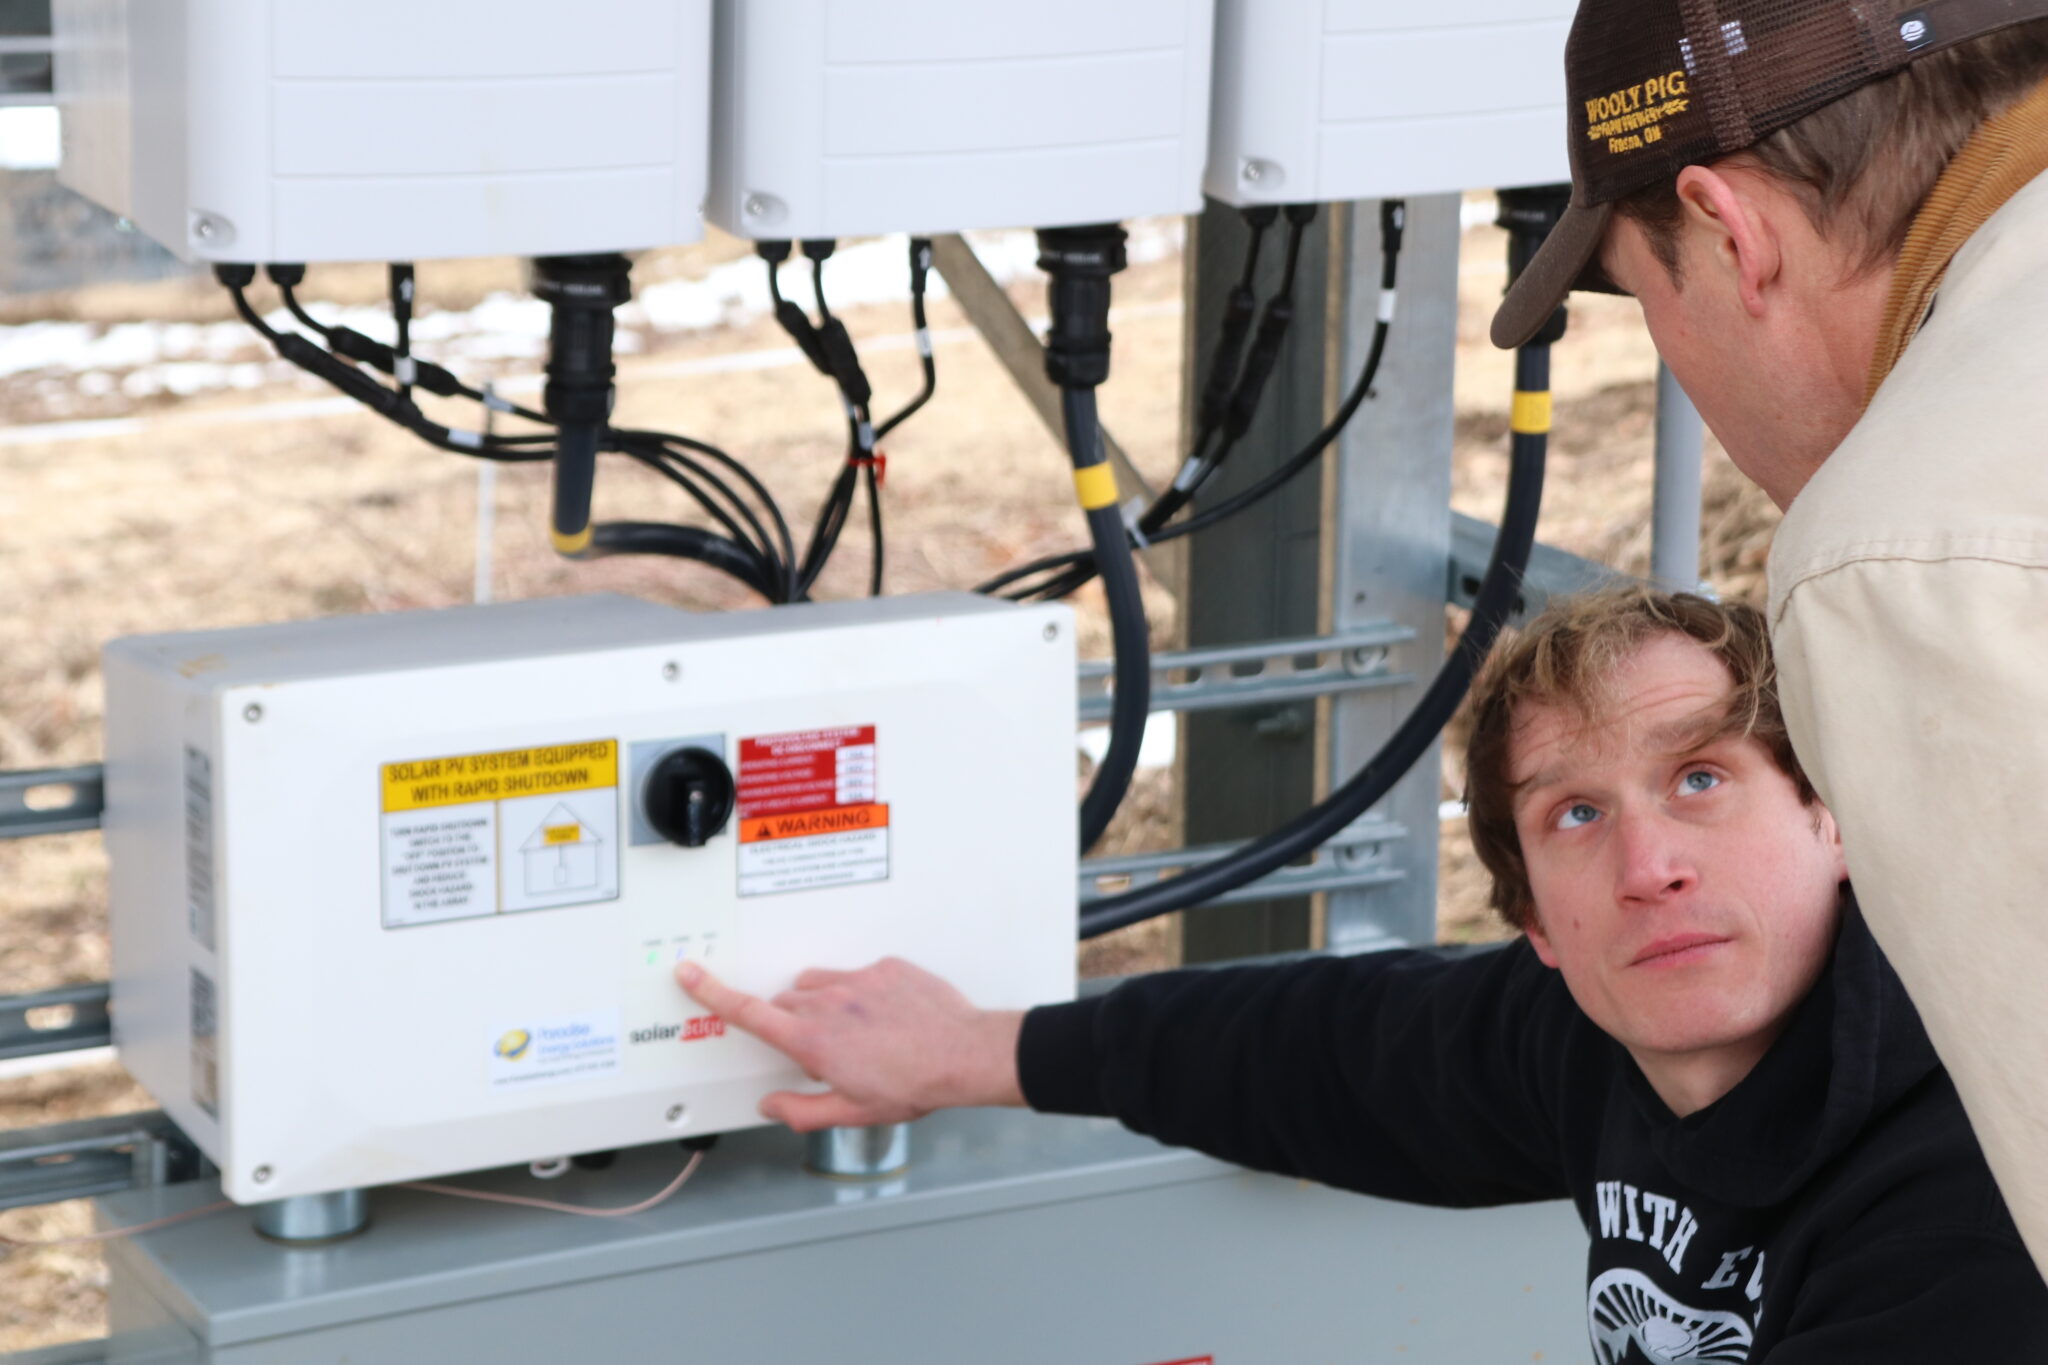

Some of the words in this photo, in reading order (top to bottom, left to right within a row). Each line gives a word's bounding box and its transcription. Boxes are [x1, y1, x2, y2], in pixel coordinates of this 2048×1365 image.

[1585, 84, 1642, 123] WOOLY
[1644, 71, 1688, 105] PIG
[389, 763, 440, 783] SOLAR
[445, 759, 464, 777] PV
[470, 751, 529, 774] SYSTEM
[533, 743, 608, 767] EQUIPPED
[411, 784, 449, 803] WITH
[453, 779, 498, 798] RAPID
[504, 768, 588, 793] SHUTDOWN
[776, 809, 871, 834] WARNING
[1596, 1180, 1698, 1275] WITH
